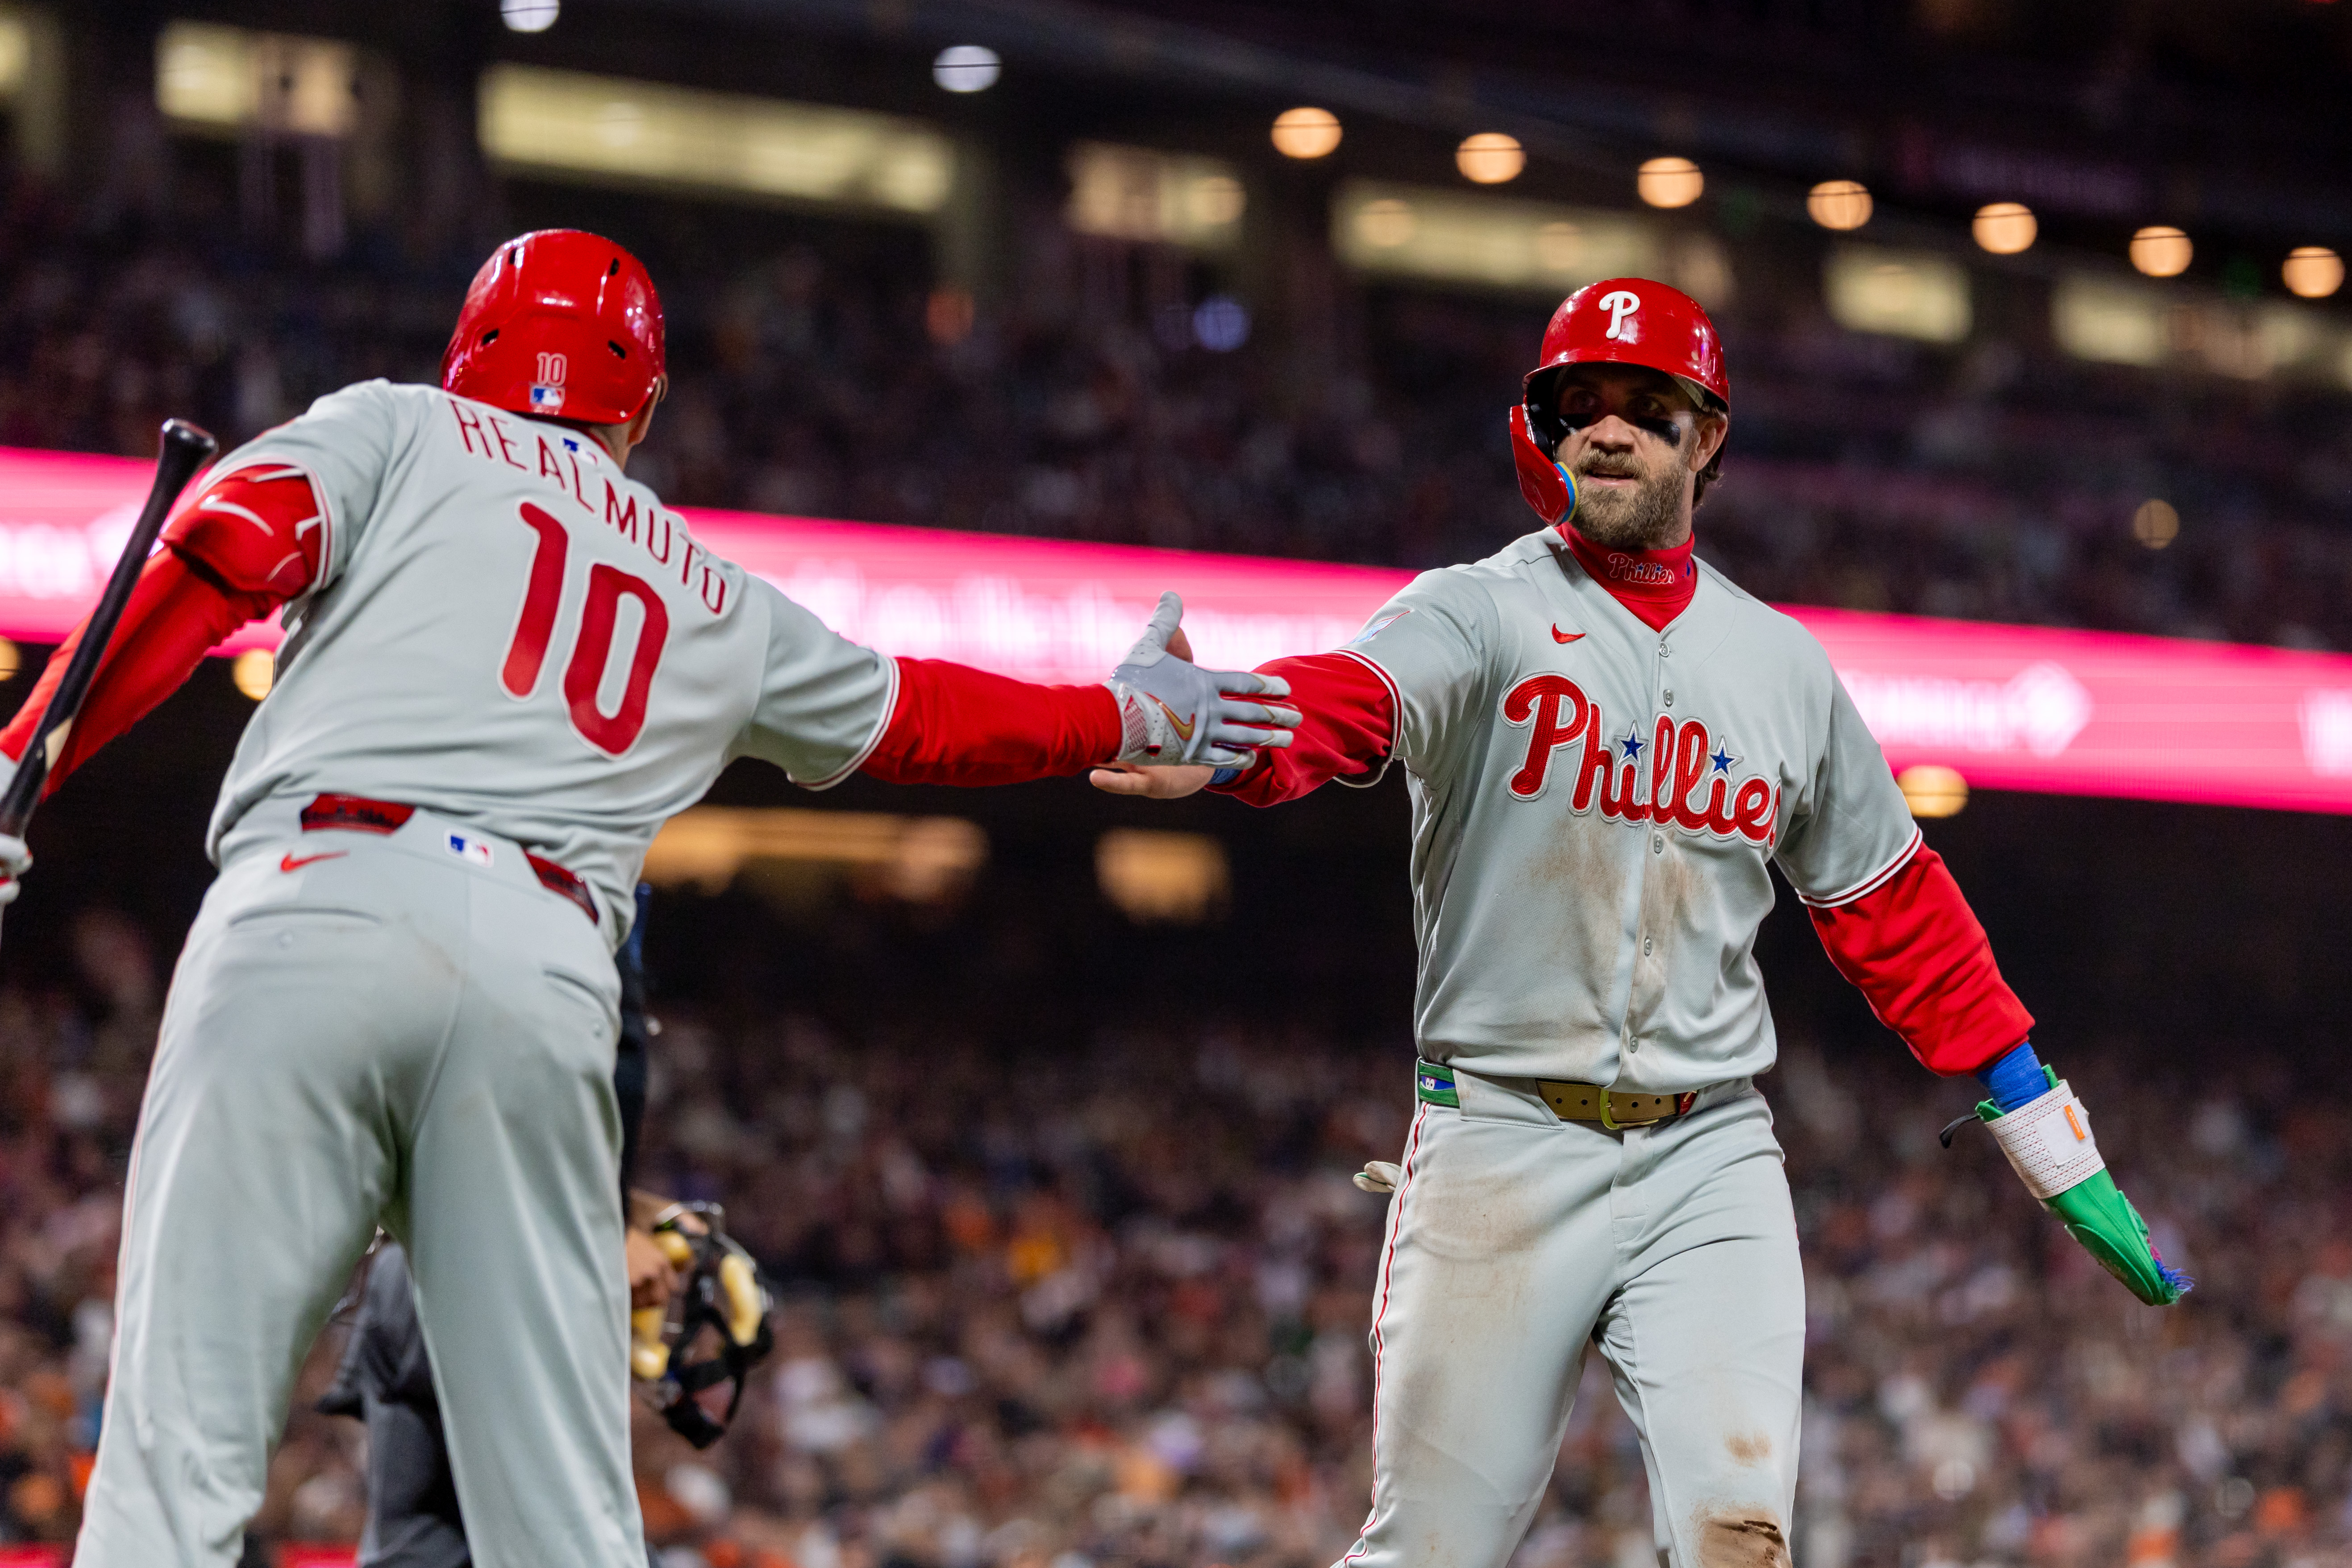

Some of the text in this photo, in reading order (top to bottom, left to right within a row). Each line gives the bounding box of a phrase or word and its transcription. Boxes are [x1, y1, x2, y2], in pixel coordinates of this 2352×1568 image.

[1599, 291, 1641, 339] P
[537, 351, 567, 387] 10
[446, 397, 728, 617] REALMUTO
[1608, 553, 1675, 585] Phillies
[498, 498, 670, 761] 10
